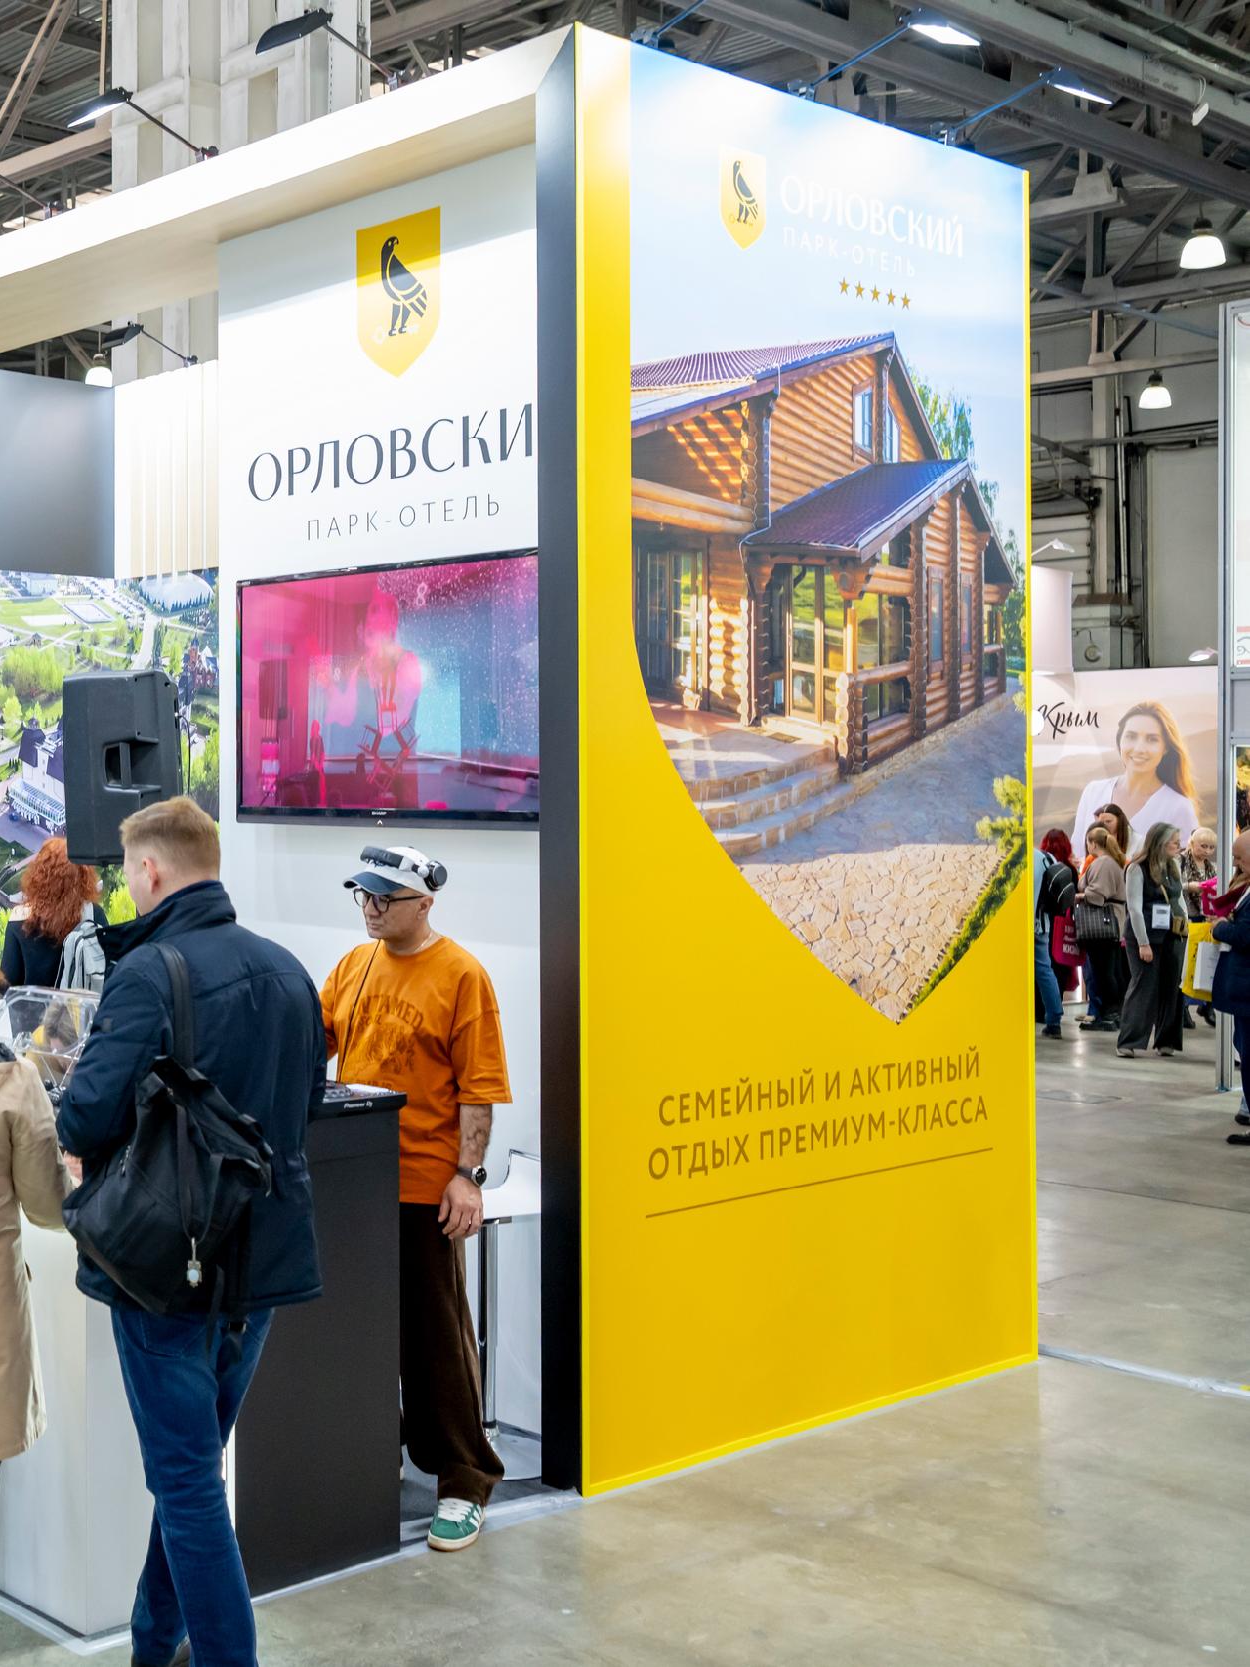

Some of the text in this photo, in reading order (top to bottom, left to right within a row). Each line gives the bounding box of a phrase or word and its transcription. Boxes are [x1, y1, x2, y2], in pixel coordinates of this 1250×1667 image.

[780, 175, 964, 258] ОРЛОВСКИЙ
[783, 226, 917, 278] ПАРК-ОТЕЛЬ
[248, 403, 533, 502] ОРЛОВСКИ
[307, 494, 501, 541] ПАРК-ОТЕЛЬ
[1037, 702, 1100, 741] Крым
[658, 1045, 980, 1127] СЕМЕЙНЫЙ И АКТИВНЫЙ
[648, 1095, 989, 1180] ОТДЫХ ПРЕМИУМ-КЛАССА
